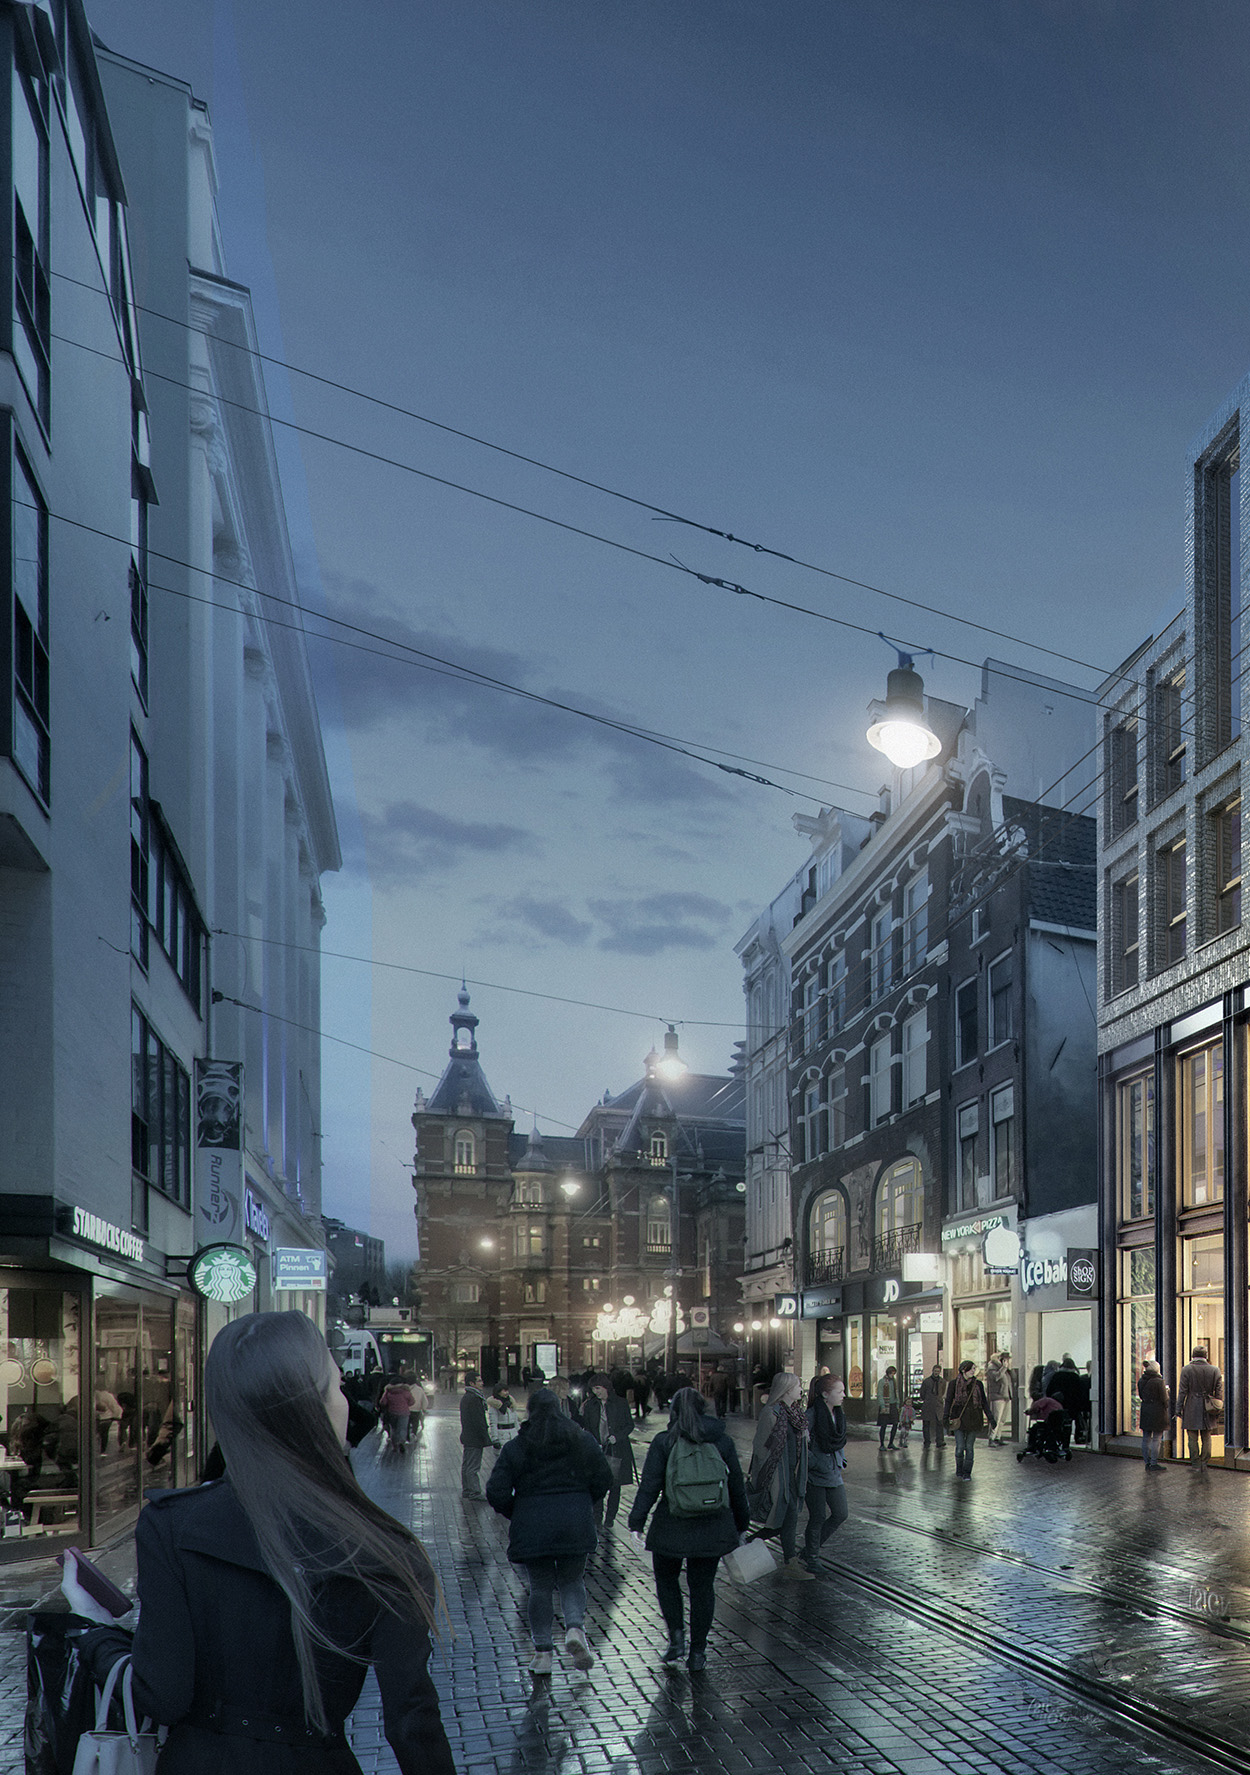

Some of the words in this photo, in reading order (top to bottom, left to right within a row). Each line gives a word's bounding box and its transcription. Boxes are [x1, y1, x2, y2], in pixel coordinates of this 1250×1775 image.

[941, 1228, 957, 1241] NEW
[957, 1221, 977, 1237] YORK
[120, 1230, 143, 1262] COFFEE
[280, 1255, 300, 1263] ATM
[280, 1263, 310, 1271] Pinnen
[883, 1279, 900, 1303] JD
[777, 1297, 797, 1315] JD
